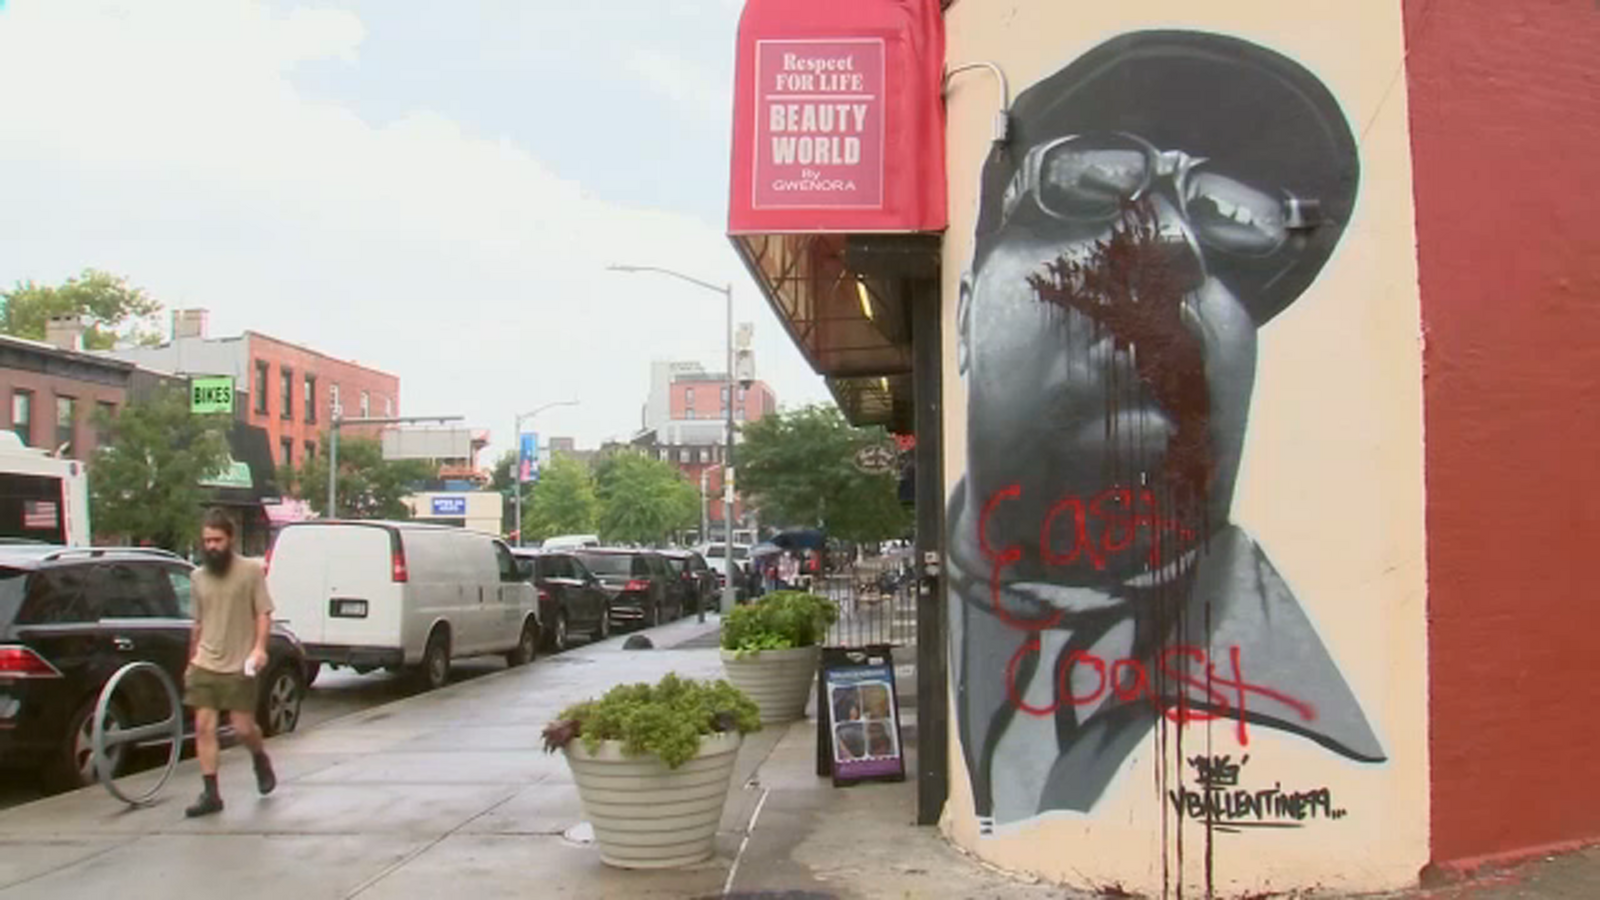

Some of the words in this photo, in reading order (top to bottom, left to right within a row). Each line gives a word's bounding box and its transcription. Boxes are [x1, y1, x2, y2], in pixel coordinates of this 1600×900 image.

[783, 53, 853, 75] Respect
[776, 74, 814, 91] FOR
[820, 74, 863, 91] LIFE
[769, 104, 867, 132] BEAUTY
[772, 136, 861, 165] WORLD
[801, 169, 820, 180] By
[772, 180, 856, 191] GWENORA
[194, 386, 231, 404] BIKES
